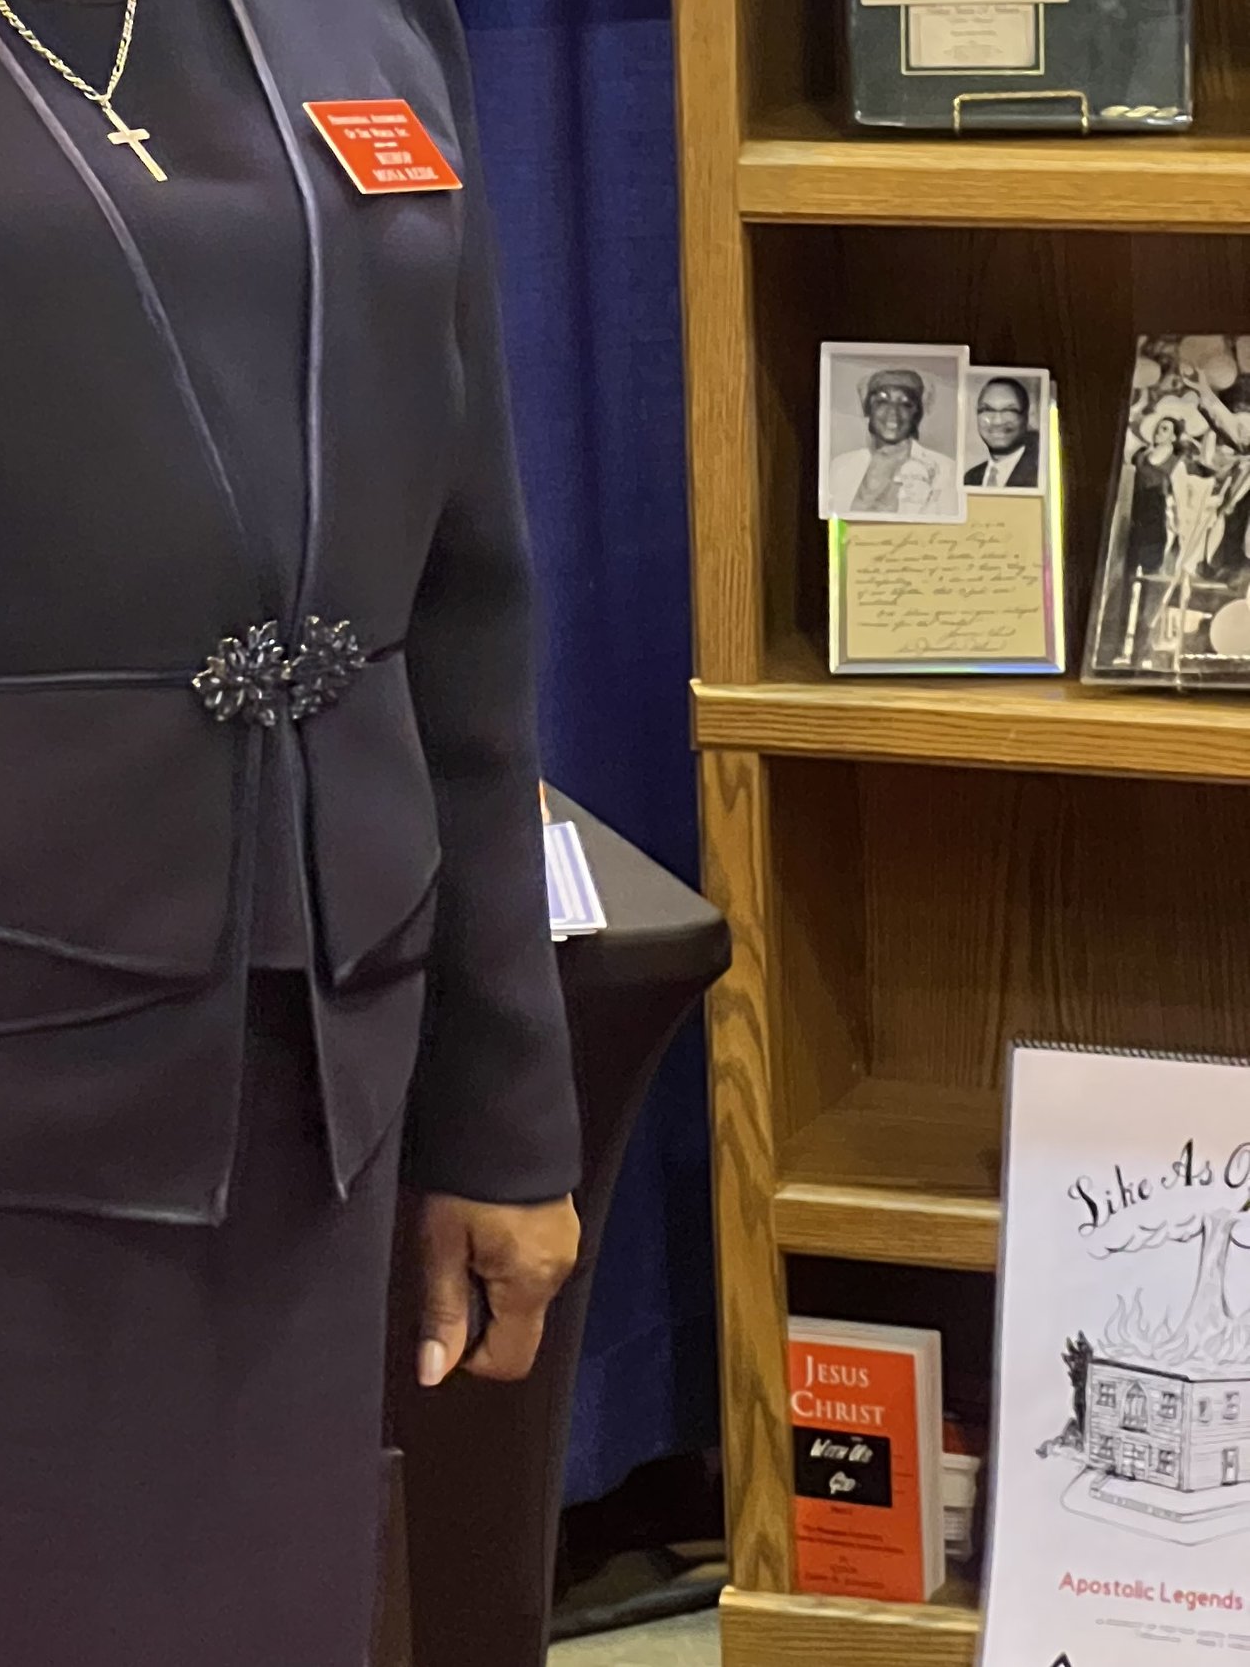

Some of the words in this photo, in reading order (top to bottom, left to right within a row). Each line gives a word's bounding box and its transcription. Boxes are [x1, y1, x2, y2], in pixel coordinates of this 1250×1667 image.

[1068, 1165, 1152, 1237] Like
[1161, 1138, 1212, 1189] As
[805, 1355, 869, 1388] JESUS
[791, 1391, 885, 1426] CHRIST
[1059, 1571, 1154, 1602] Apostolic
[1160, 1582, 1243, 1611] Legends
